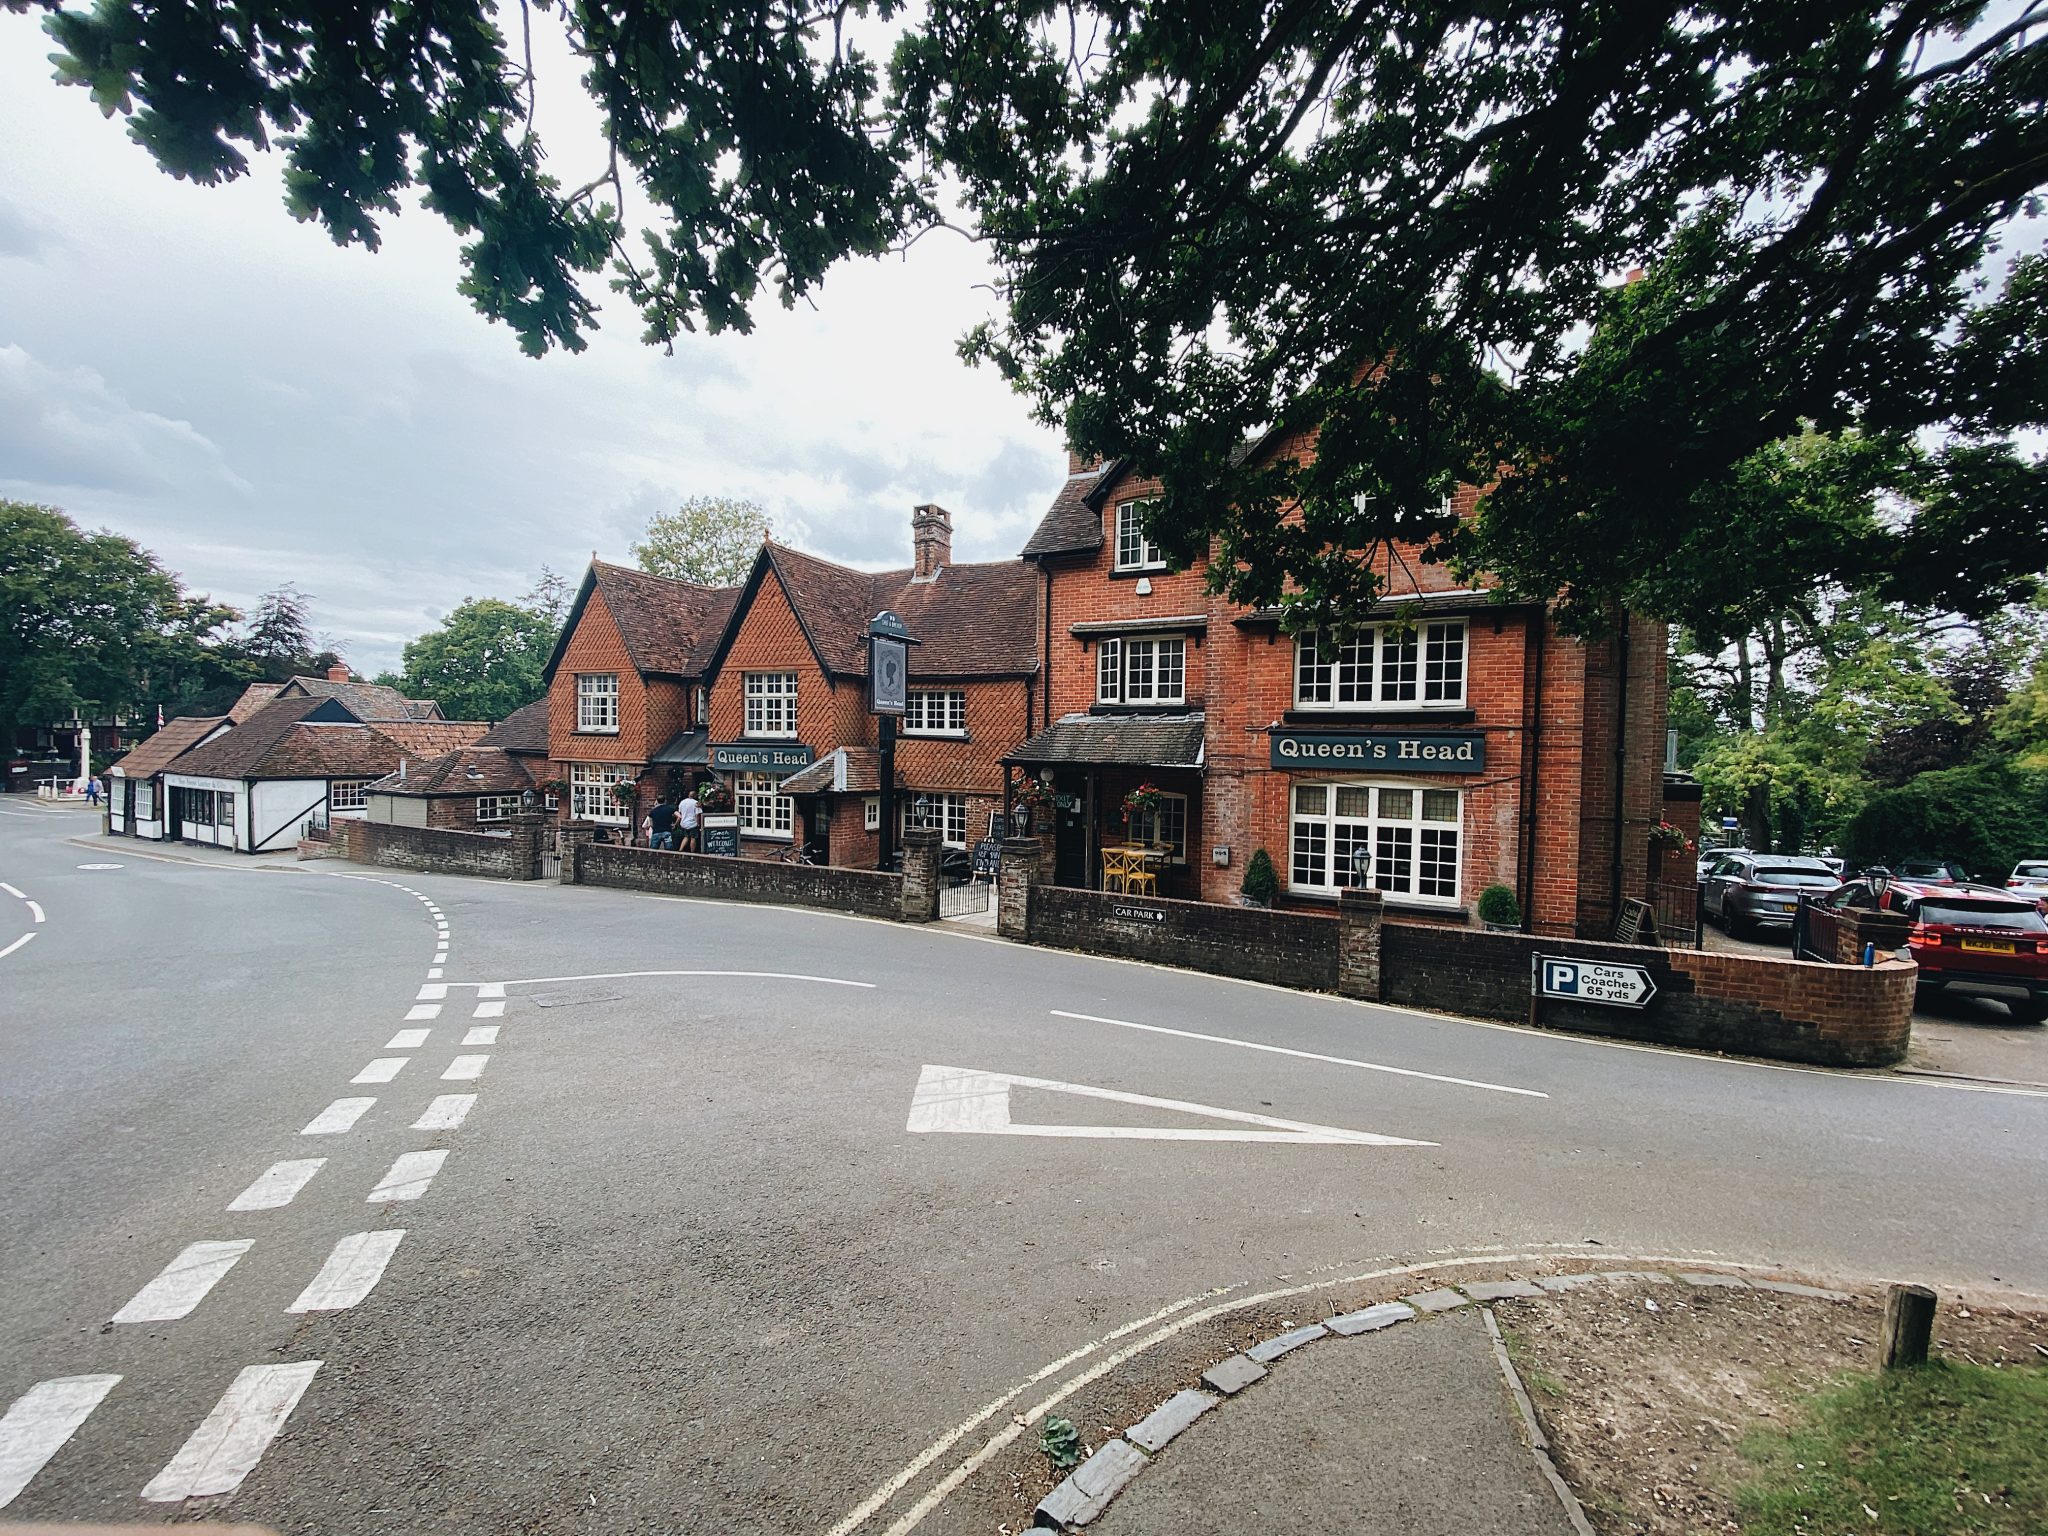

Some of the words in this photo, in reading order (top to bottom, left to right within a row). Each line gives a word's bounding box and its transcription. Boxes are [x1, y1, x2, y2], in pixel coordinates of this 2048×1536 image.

[1279, 738, 1386, 759] Queen's
[1397, 740, 1474, 761] Head
[717, 750, 769, 764] Queen's
[773, 751, 808, 765] Head
[980, 842, 1001, 852] PLEASE
[1115, 907, 1133, 917] CAR
[1133, 909, 1154, 920] PARK
[1552, 965, 1574, 991] P
[1593, 967, 1625, 979] Cars
[1581, 975, 1637, 990] Coaches
[1586, 986, 1603, 996] 65
[1606, 990, 1630, 999] yds
